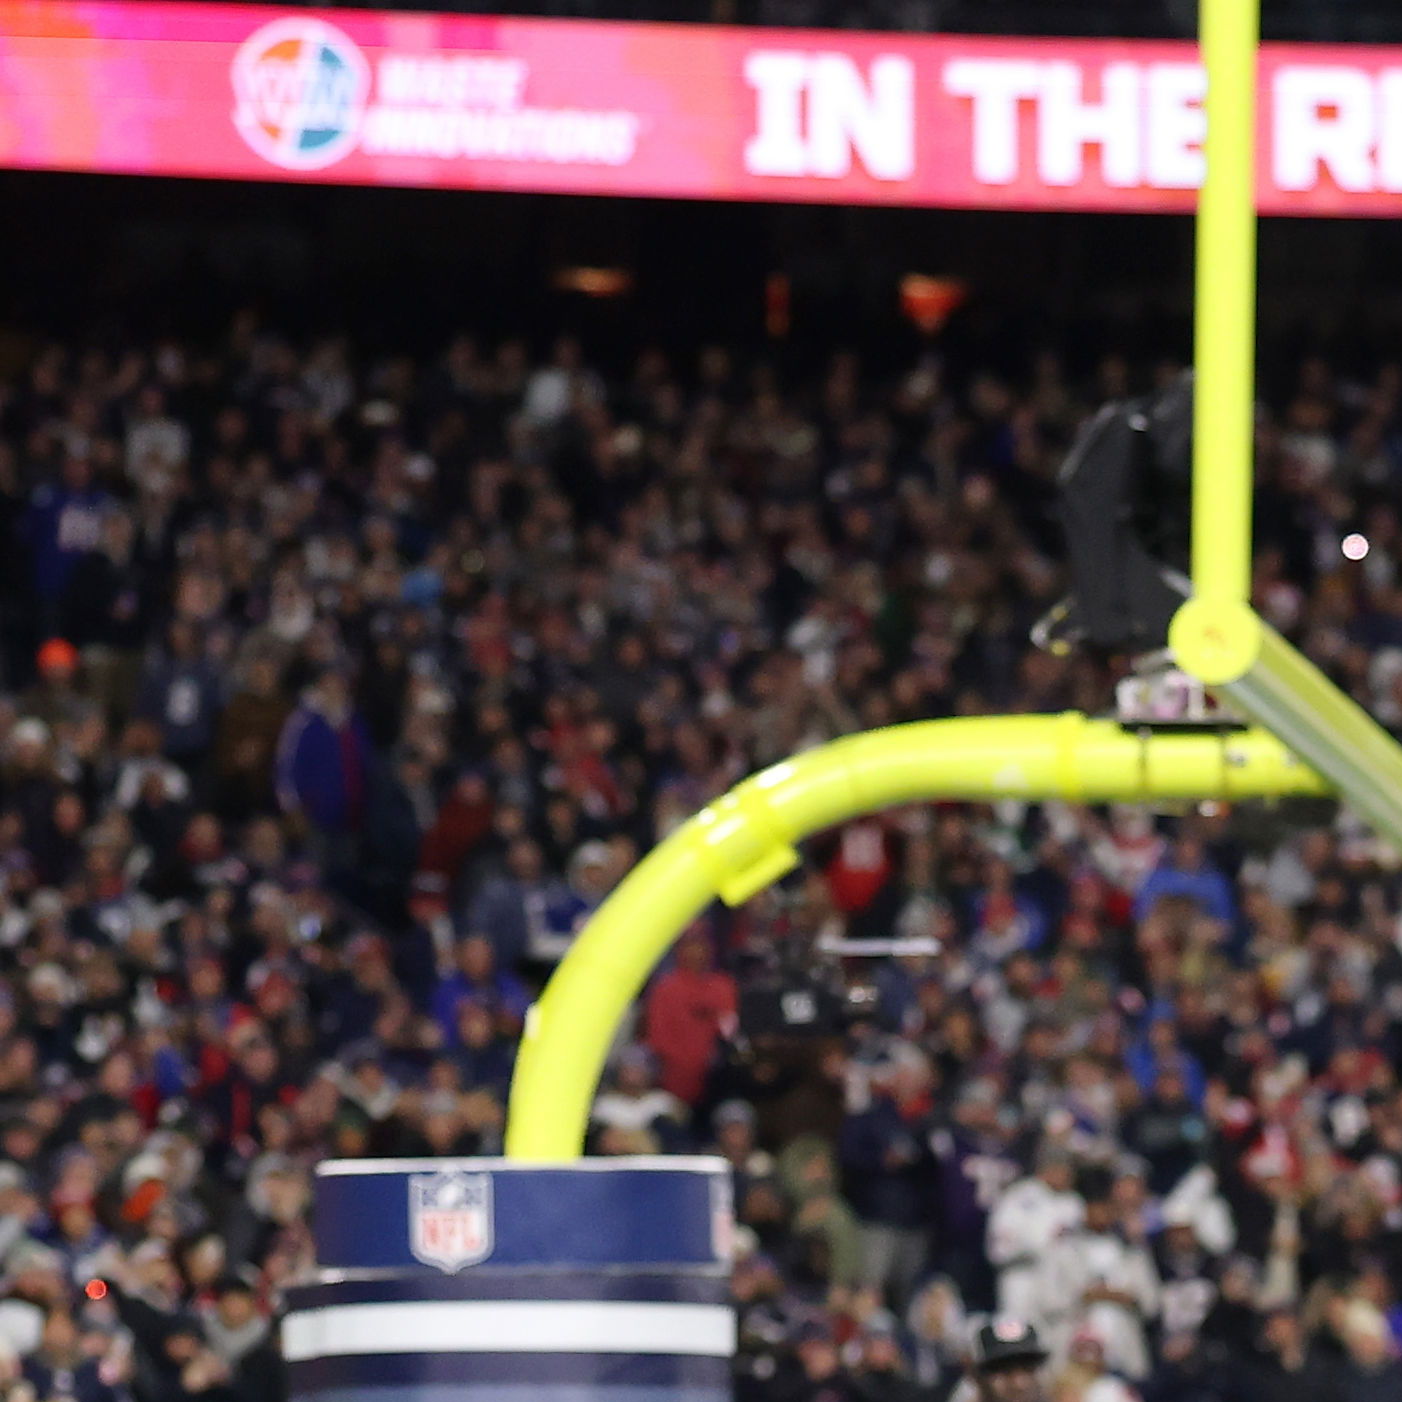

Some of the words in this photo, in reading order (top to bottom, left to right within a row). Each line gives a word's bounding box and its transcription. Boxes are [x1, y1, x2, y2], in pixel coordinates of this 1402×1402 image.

[744, 50, 914, 181] IN
[942, 58, 1207, 189] THE
[421, 1213, 482, 1254] NFL
